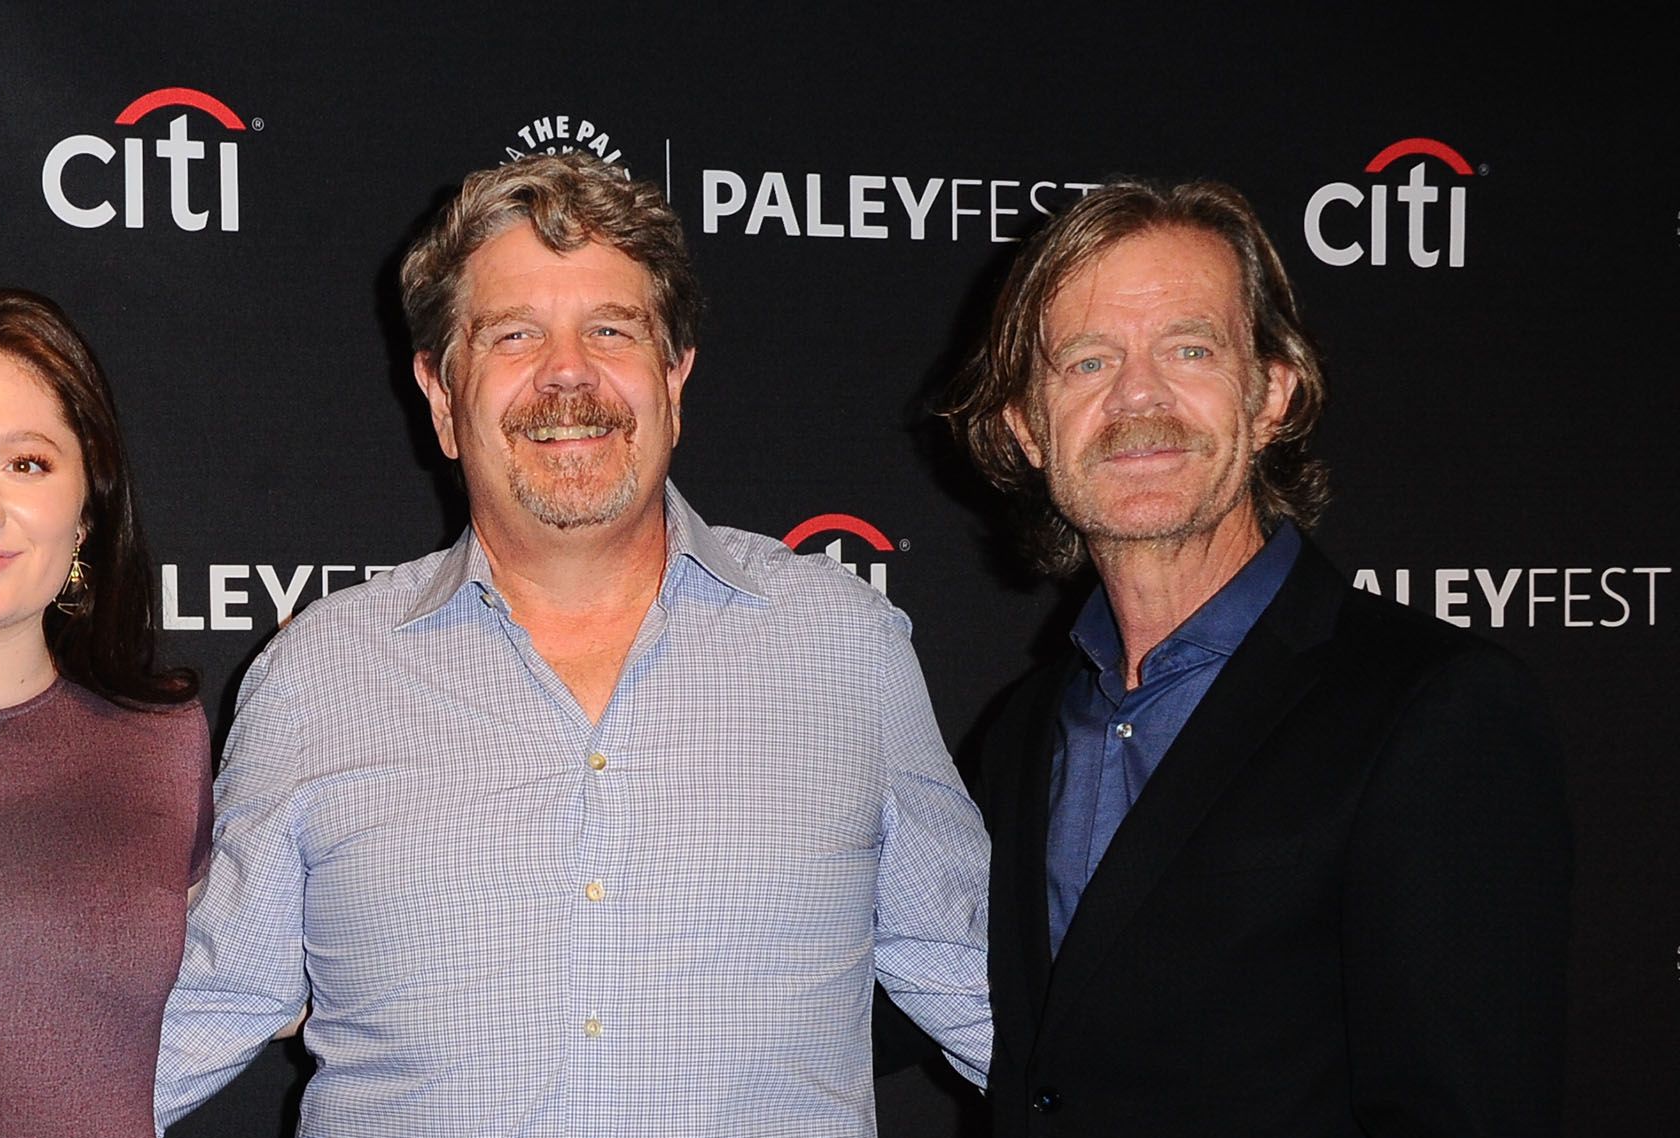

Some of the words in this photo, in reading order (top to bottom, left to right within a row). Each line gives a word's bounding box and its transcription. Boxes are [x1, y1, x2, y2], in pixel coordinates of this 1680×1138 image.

[42, 114, 239, 231] citi
[518, 116, 569, 149] THE
[576, 120, 631, 181] PAL
[1304, 162, 1465, 267] citi
[162, 564, 397, 629] LEY
